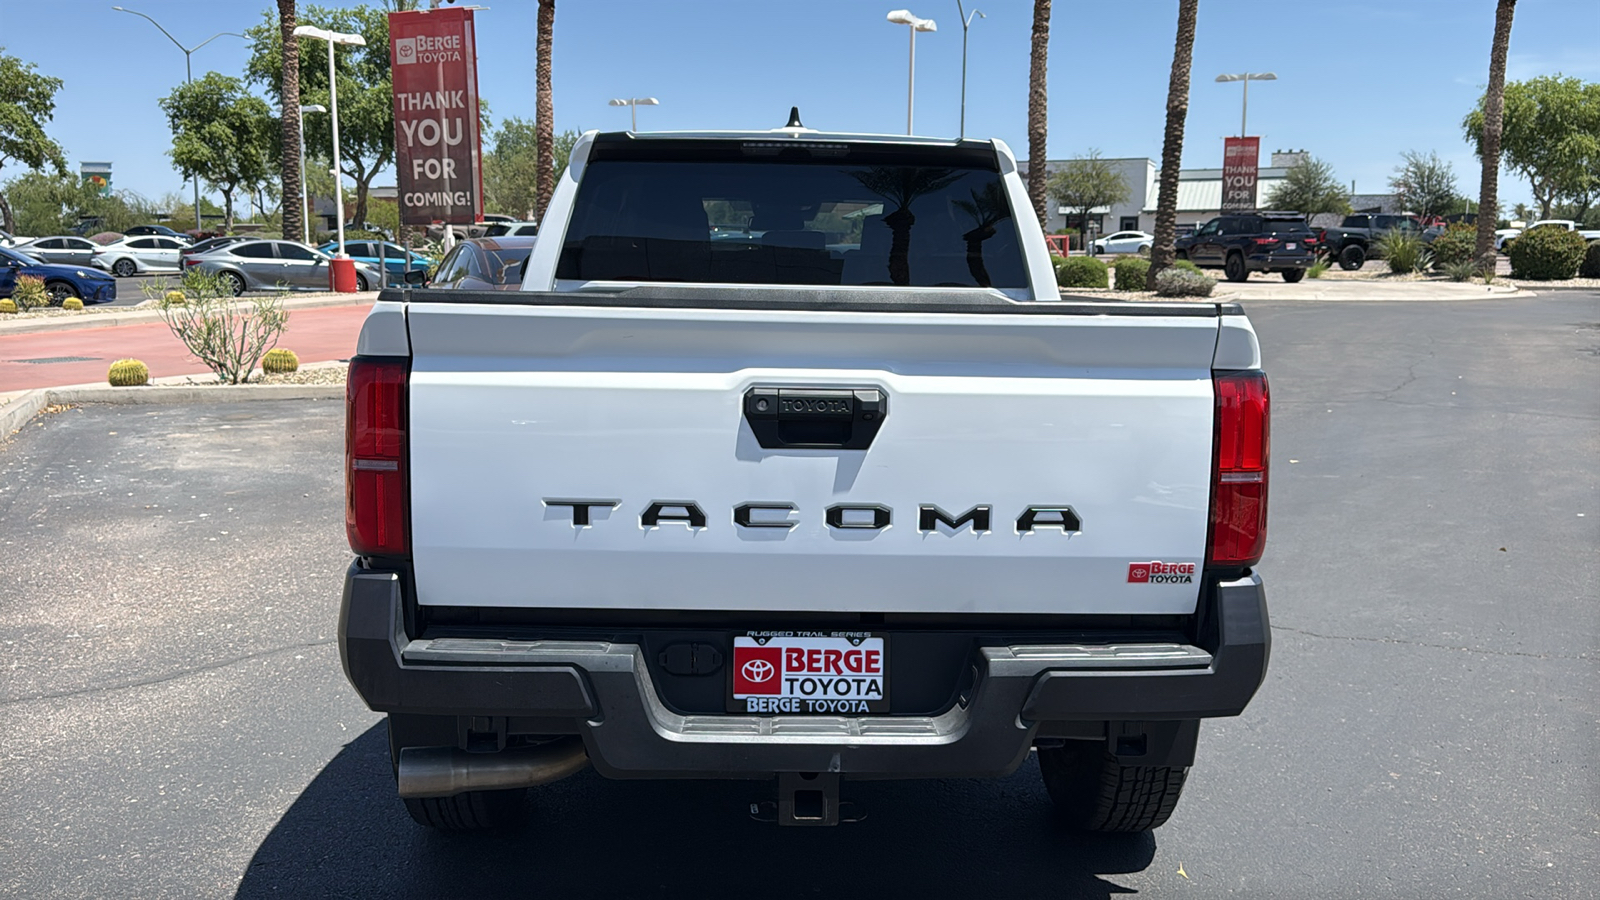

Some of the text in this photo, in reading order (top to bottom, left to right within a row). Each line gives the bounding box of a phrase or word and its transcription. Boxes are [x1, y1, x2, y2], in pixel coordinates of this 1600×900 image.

[416, 35, 460, 51] BERGE
[417, 51, 461, 64] TOYOTA
[397, 90, 465, 111] THANK
[400, 117, 463, 147] YOU
[412, 158, 457, 180] FOR
[1225, 166, 1257, 174] THANK
[1225, 176, 1255, 188] YOU
[404, 191, 471, 207] COMING!
[1228, 190, 1250, 199] FOR
[782, 400, 850, 413] TOYOTA
[541, 498, 1085, 534] TACOMA
[1151, 561, 1195, 575] BERGE
[1150, 575, 1193, 584] TOYOTA
[785, 647, 881, 676] BERGE
[785, 677, 882, 696] TOYOTA
[746, 697, 870, 714] BERGE TOYOTA
